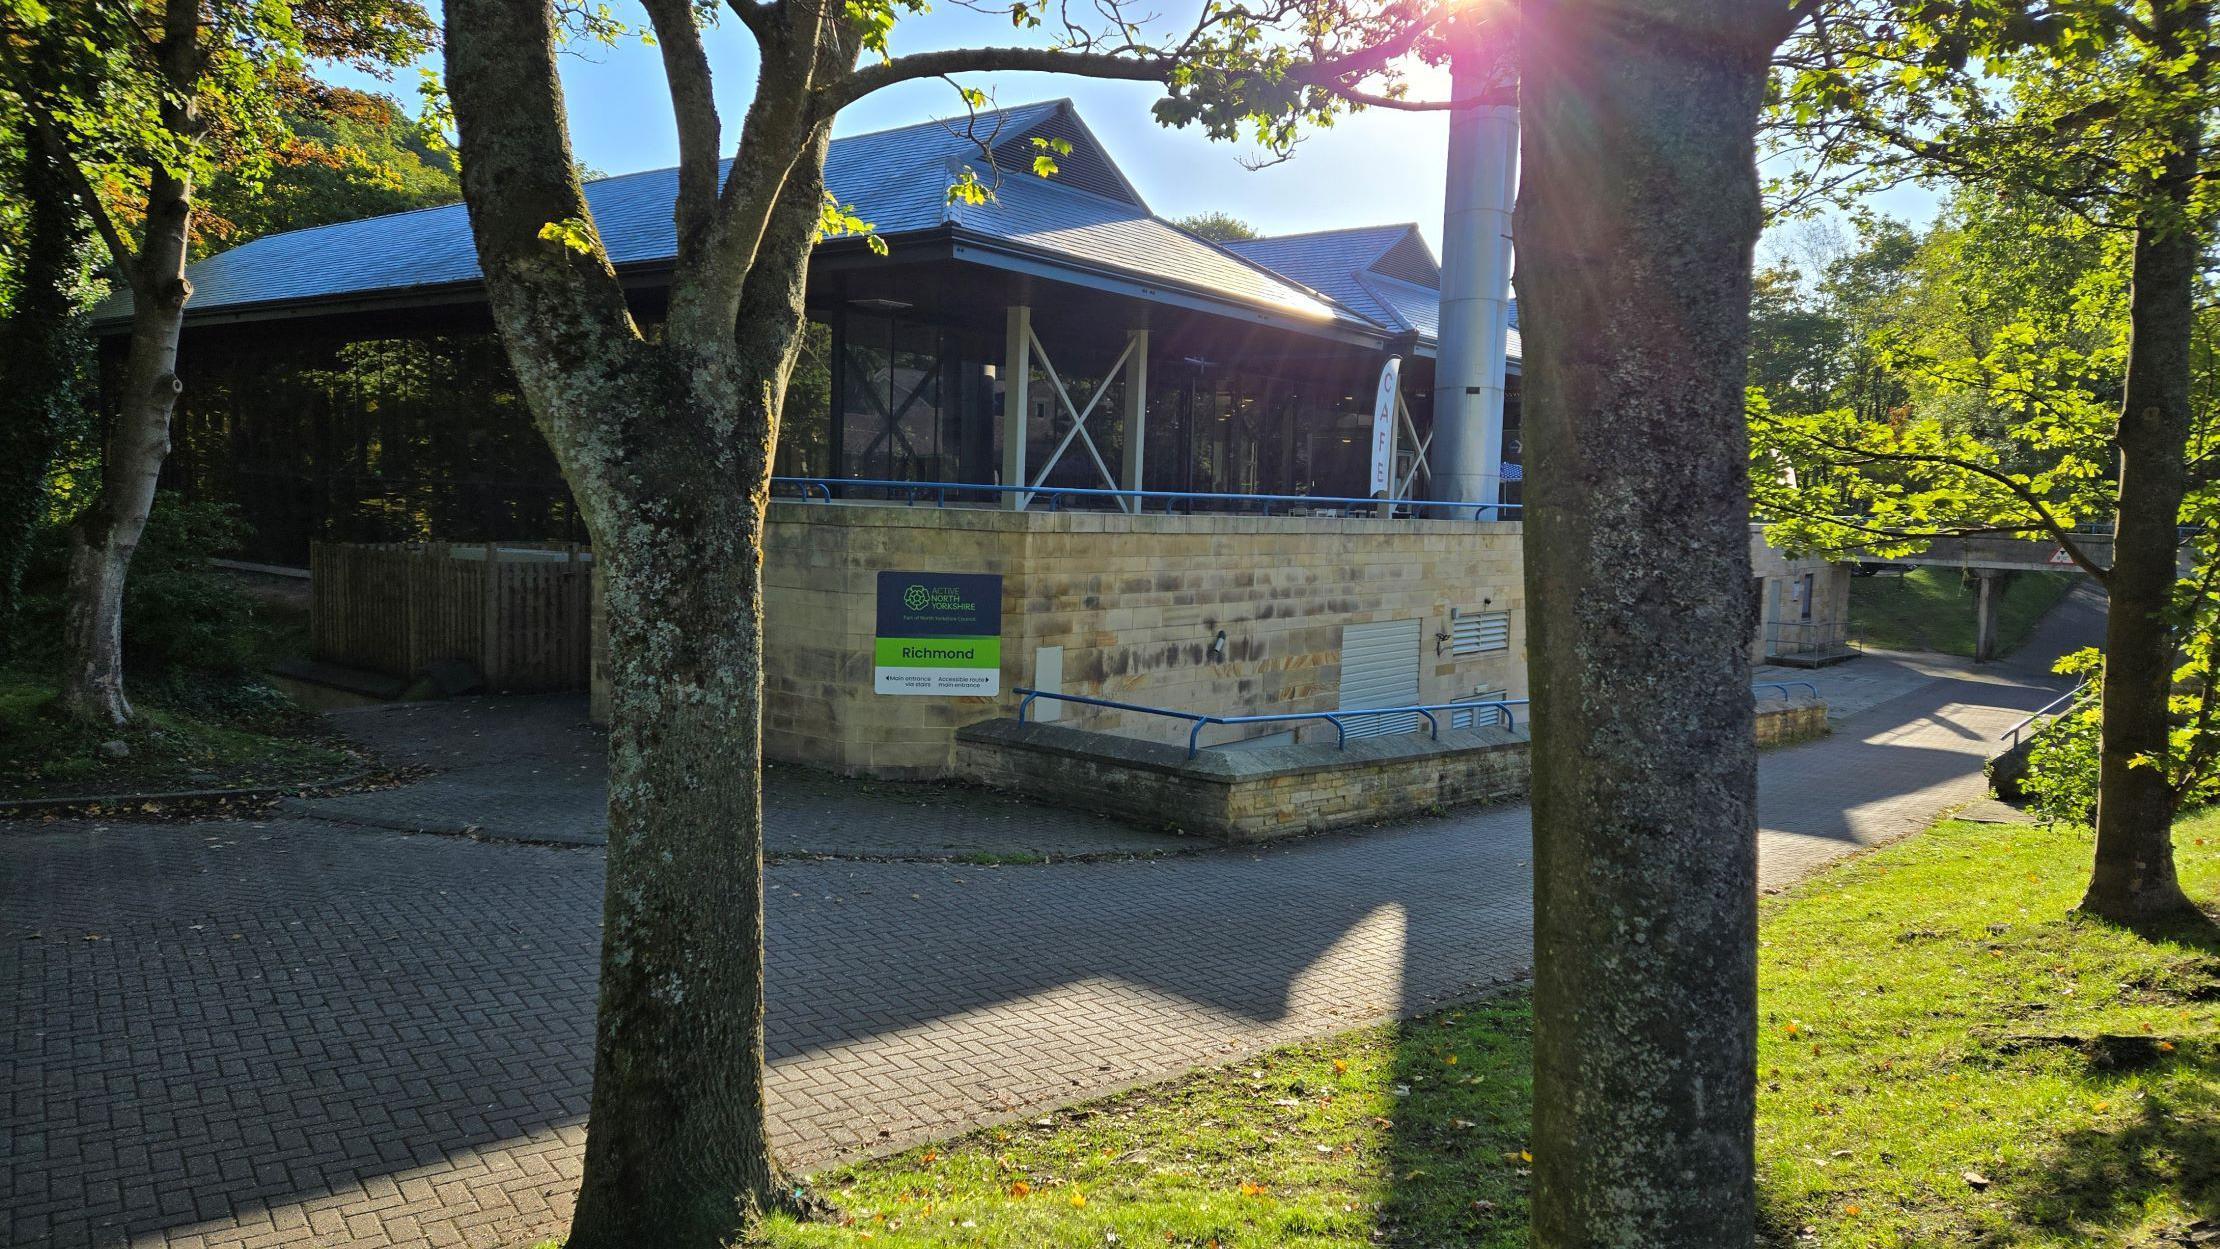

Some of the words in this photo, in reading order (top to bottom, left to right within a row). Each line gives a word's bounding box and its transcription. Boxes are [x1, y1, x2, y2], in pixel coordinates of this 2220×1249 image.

[931, 587, 960, 595] ACTIVE
[931, 595, 960, 603] NORTH
[931, 602, 976, 611] YORKSHIRE
[902, 646, 974, 660] Richmond
